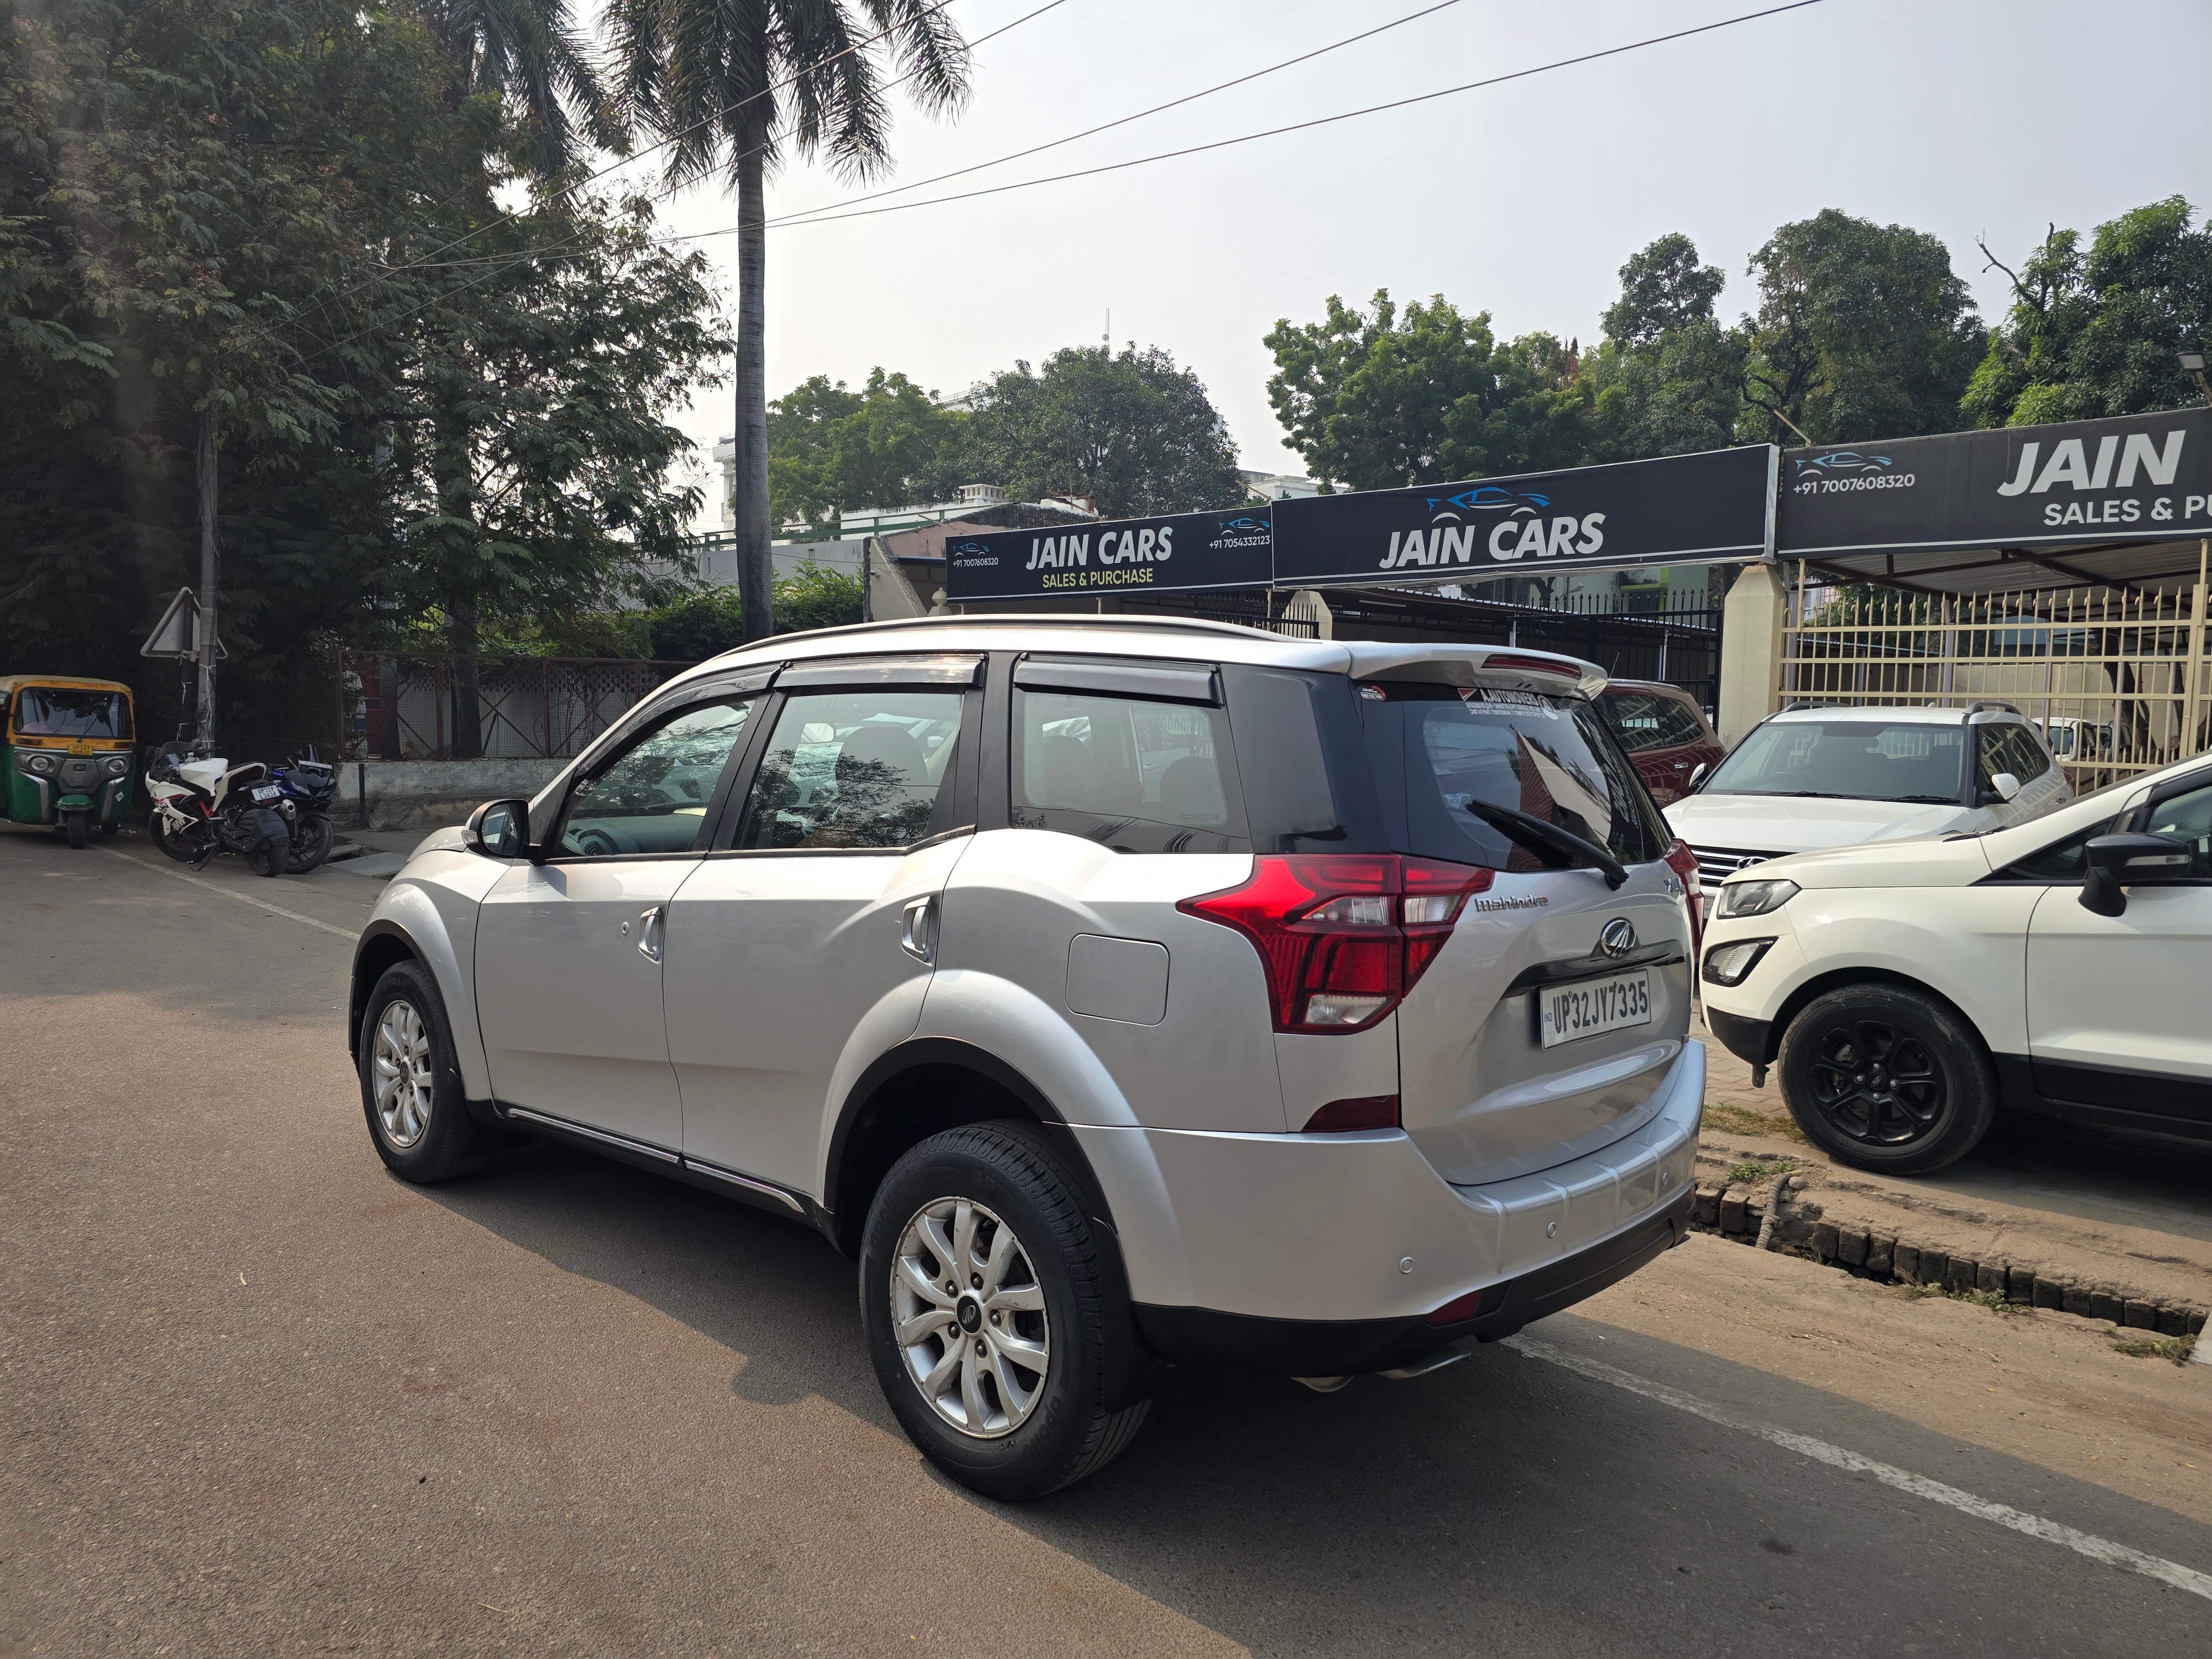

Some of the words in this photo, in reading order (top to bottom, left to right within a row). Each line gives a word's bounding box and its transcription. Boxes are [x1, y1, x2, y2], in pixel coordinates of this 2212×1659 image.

[1996, 430, 2186, 496] JAIN
[1793, 482, 1817, 494] +91
[1821, 474, 1915, 493] 7007608320
[2043, 499, 2141, 526] SALES
[2151, 497, 2173, 521] &
[1025, 534, 1089, 570] JAIN
[1098, 526, 1173, 565] CARS
[1209, 539, 1222, 549] +91
[1223, 535, 1270, 548] 7054332123
[1379, 525, 1475, 568] JAIN
[1489, 513, 1606, 560] CARS
[963, 557, 999, 567] 7007608320
[1042, 572, 1076, 588] SALES
[1079, 572, 1087, 586] &
[1090, 568, 1153, 585] PURCHASE
[1543, 1013, 1552, 1023] IND
[1553, 980, 1648, 1033] UP32JY7335
